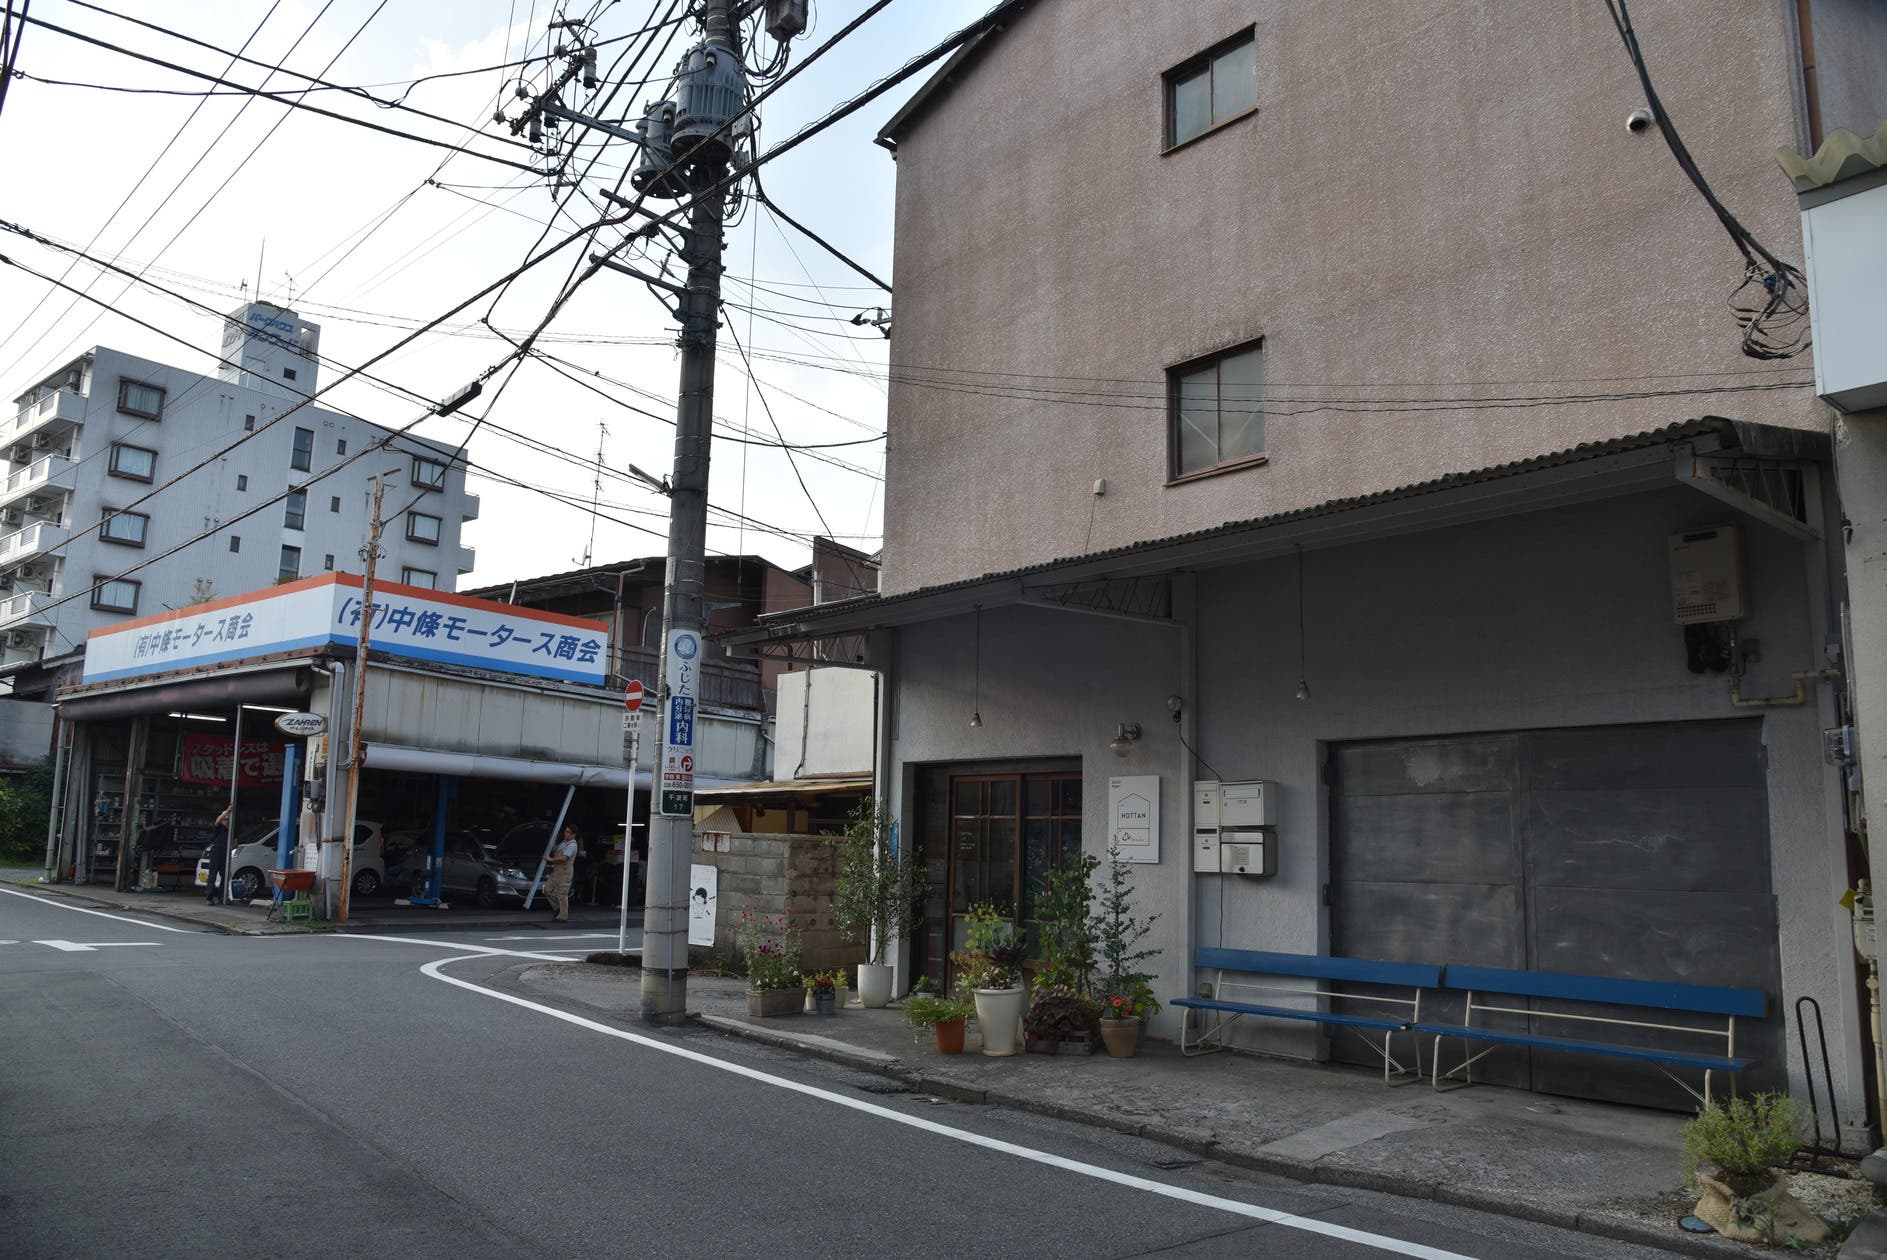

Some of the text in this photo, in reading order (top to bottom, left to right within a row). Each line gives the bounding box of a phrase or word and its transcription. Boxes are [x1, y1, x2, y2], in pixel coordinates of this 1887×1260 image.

[337, 597, 601, 664] (有)中條モータース商会
[679, 661, 691, 695] ふじた
[676, 720, 689, 744] 内科
[1121, 812, 1147, 820] HOTTAN
